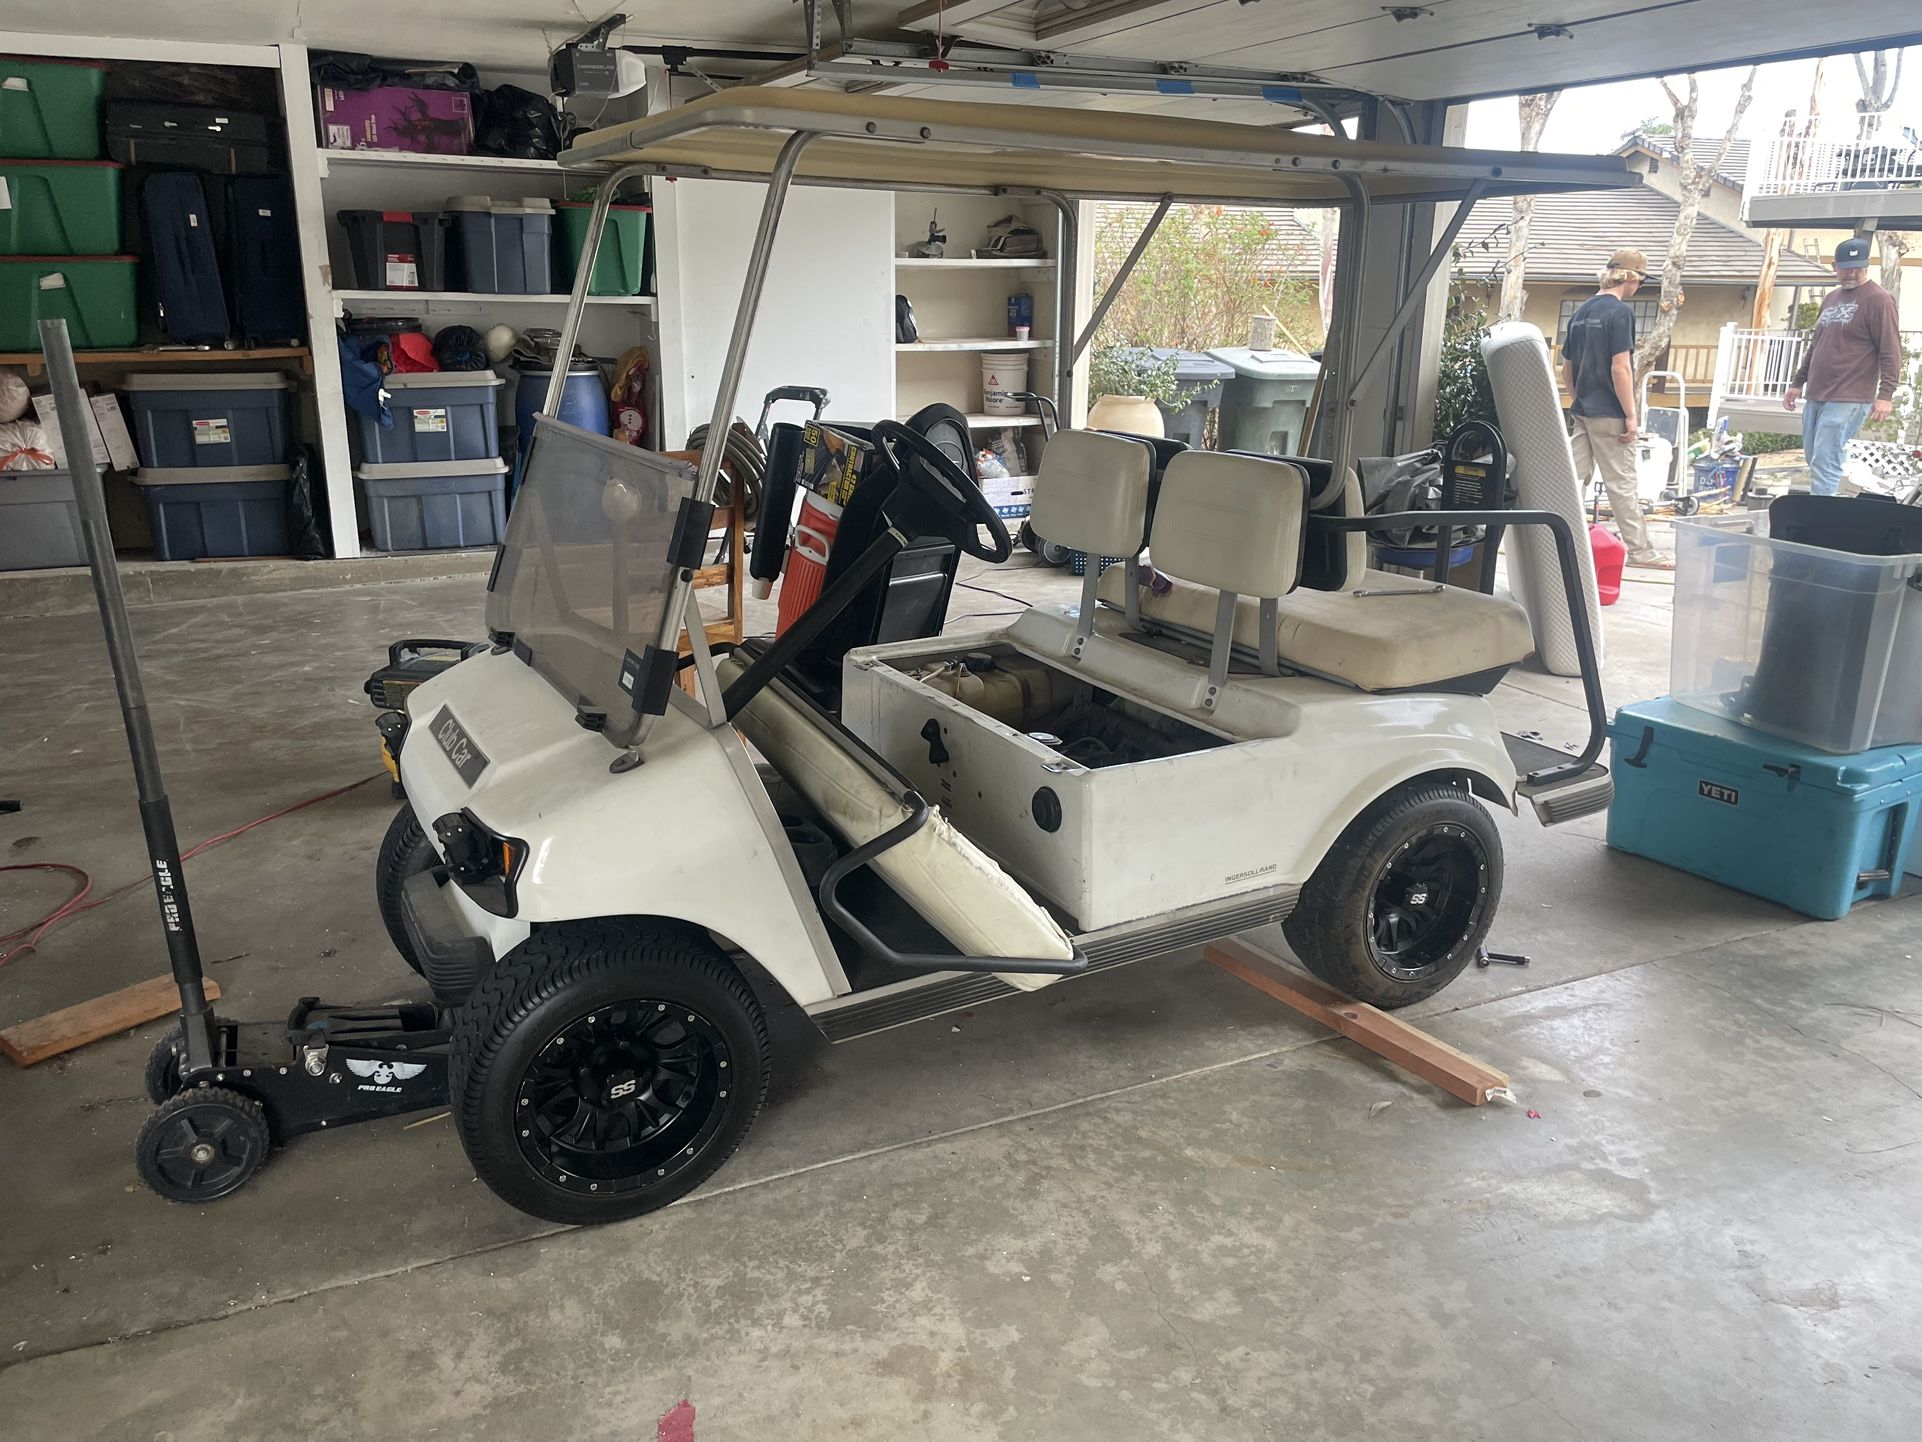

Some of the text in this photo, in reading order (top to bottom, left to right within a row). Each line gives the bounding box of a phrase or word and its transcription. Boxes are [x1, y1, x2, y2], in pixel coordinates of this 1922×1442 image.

[810, 428, 818, 444] 50
[438, 718, 472, 769] Club Car
[1701, 782, 1737, 803] YETI
[1410, 893, 1427, 905] SS
[610, 1079, 636, 1099] SS
